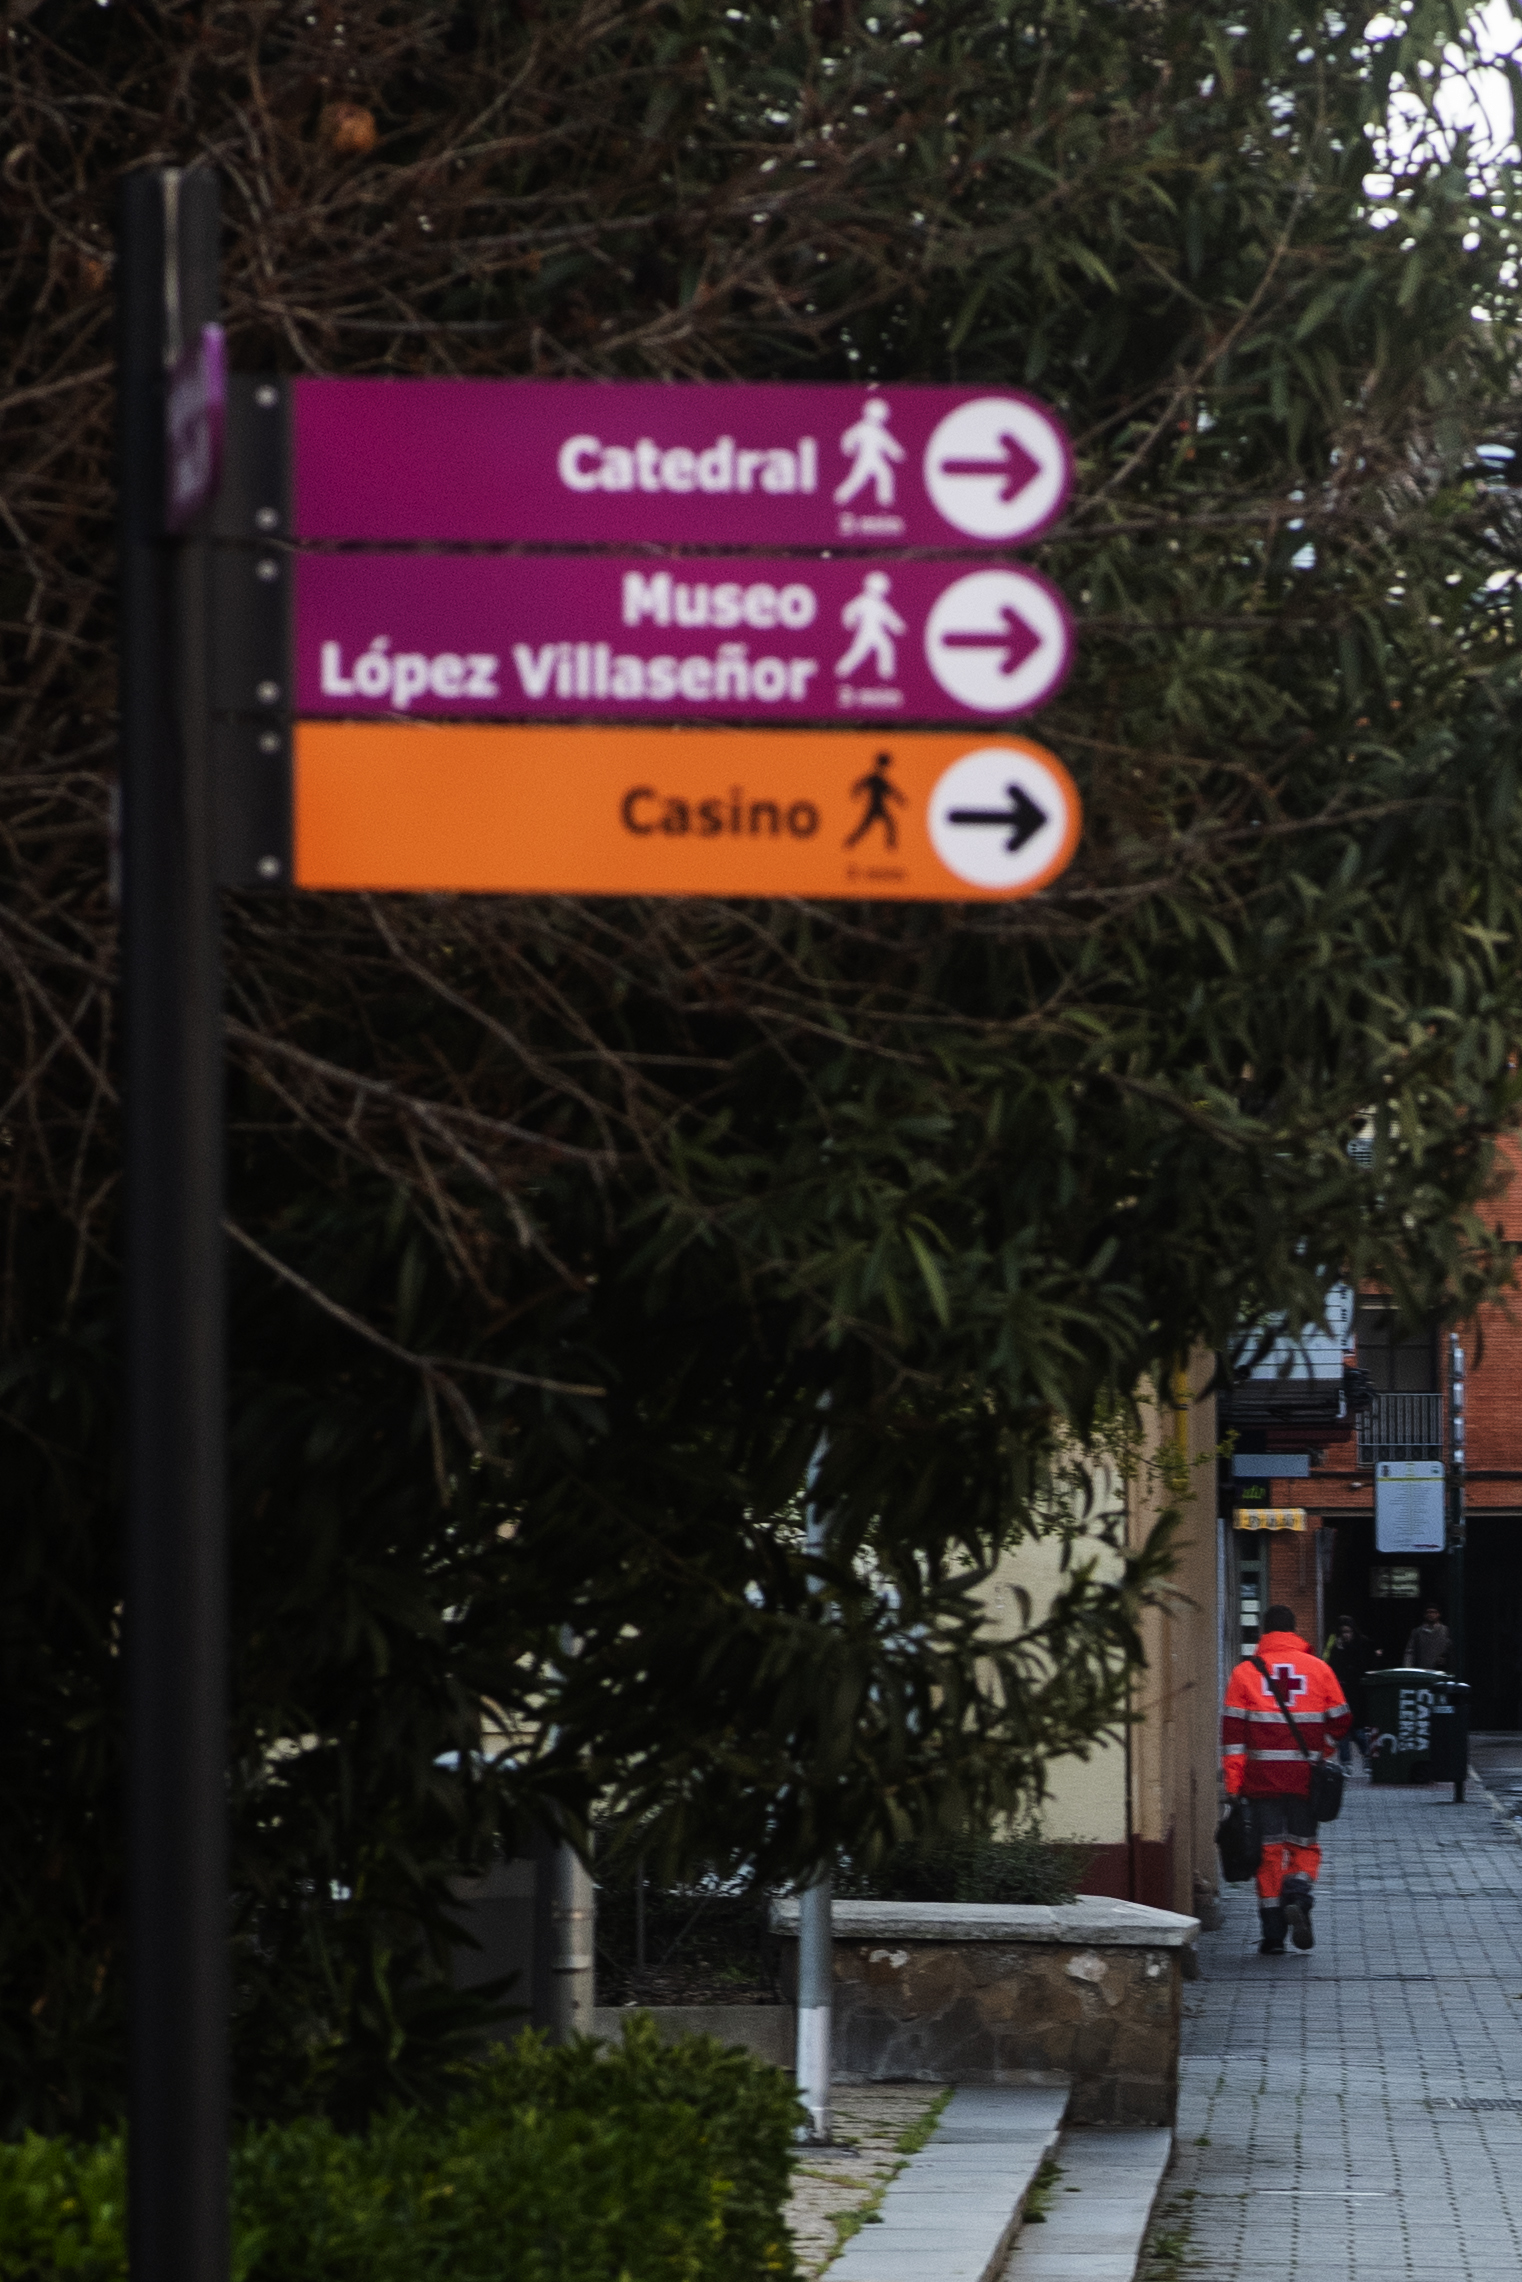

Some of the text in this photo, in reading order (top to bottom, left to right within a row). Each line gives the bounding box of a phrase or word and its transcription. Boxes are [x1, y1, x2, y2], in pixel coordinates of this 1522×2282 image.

[559, 435, 816, 493] Catedral
[623, 572, 816, 628] Museo
[322, 637, 817, 708] López Villaseñor
[621, 785, 821, 839] Casino
